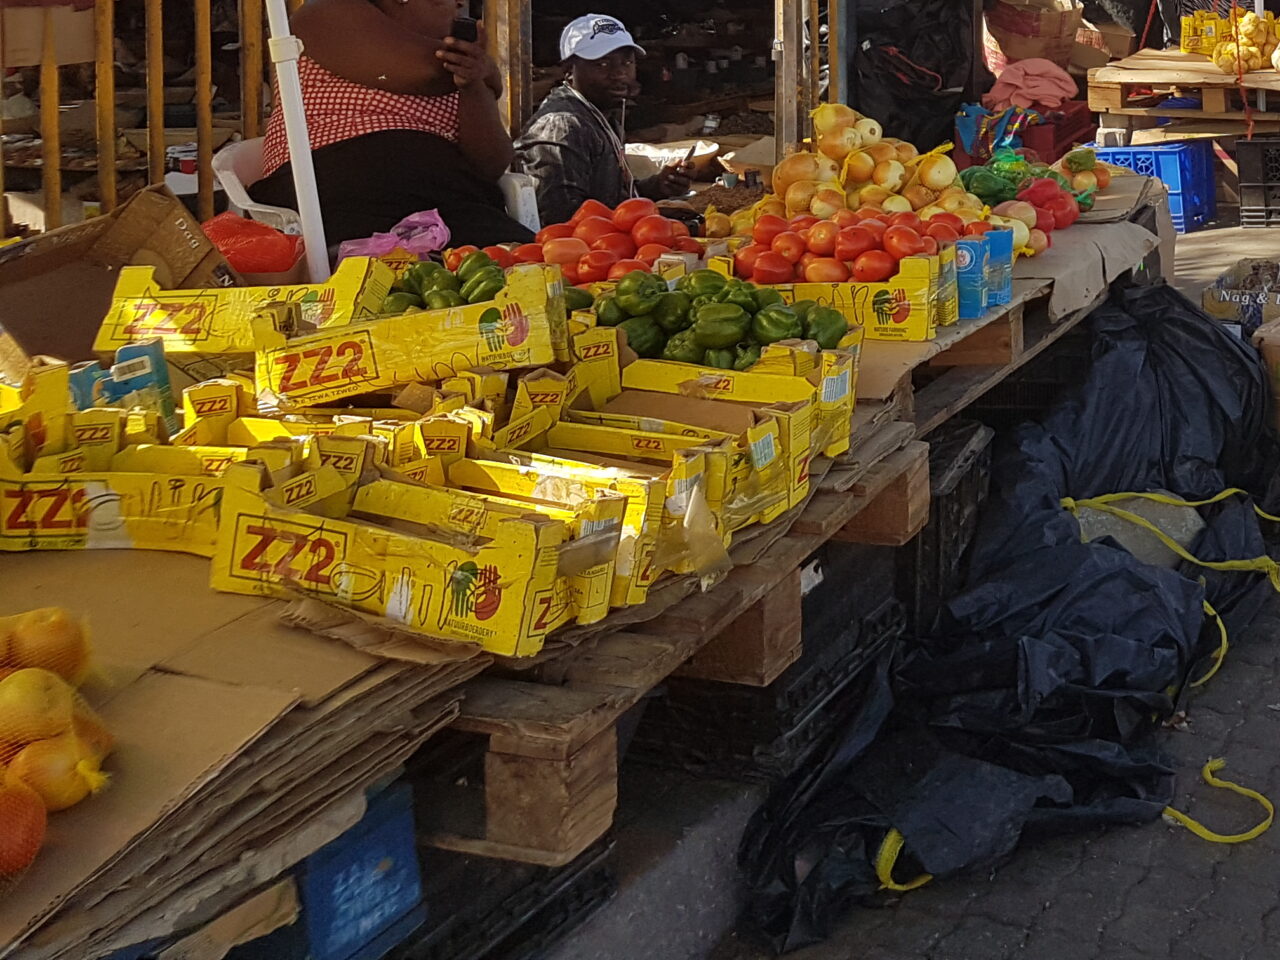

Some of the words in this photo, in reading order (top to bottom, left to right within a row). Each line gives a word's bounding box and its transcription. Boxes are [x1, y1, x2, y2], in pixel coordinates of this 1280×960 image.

[1220, 290, 1249, 306] Nag
[1256, 291, 1269, 304] &
[123, 303, 206, 335] ZZ2
[582, 344, 611, 359] ZZ2
[274, 340, 367, 395] ZZ2
[530, 392, 559, 403] ZZ2
[194, 398, 230, 414] ZZ2
[75, 426, 110, 440] ZZ2
[508, 422, 531, 442] ZZ2
[426, 439, 457, 451] ZZ2
[633, 438, 661, 450] ZZ2
[321, 455, 355, 471] ZZ2
[285, 480, 314, 504] ZZ2
[240, 524, 336, 585] ZZ2
